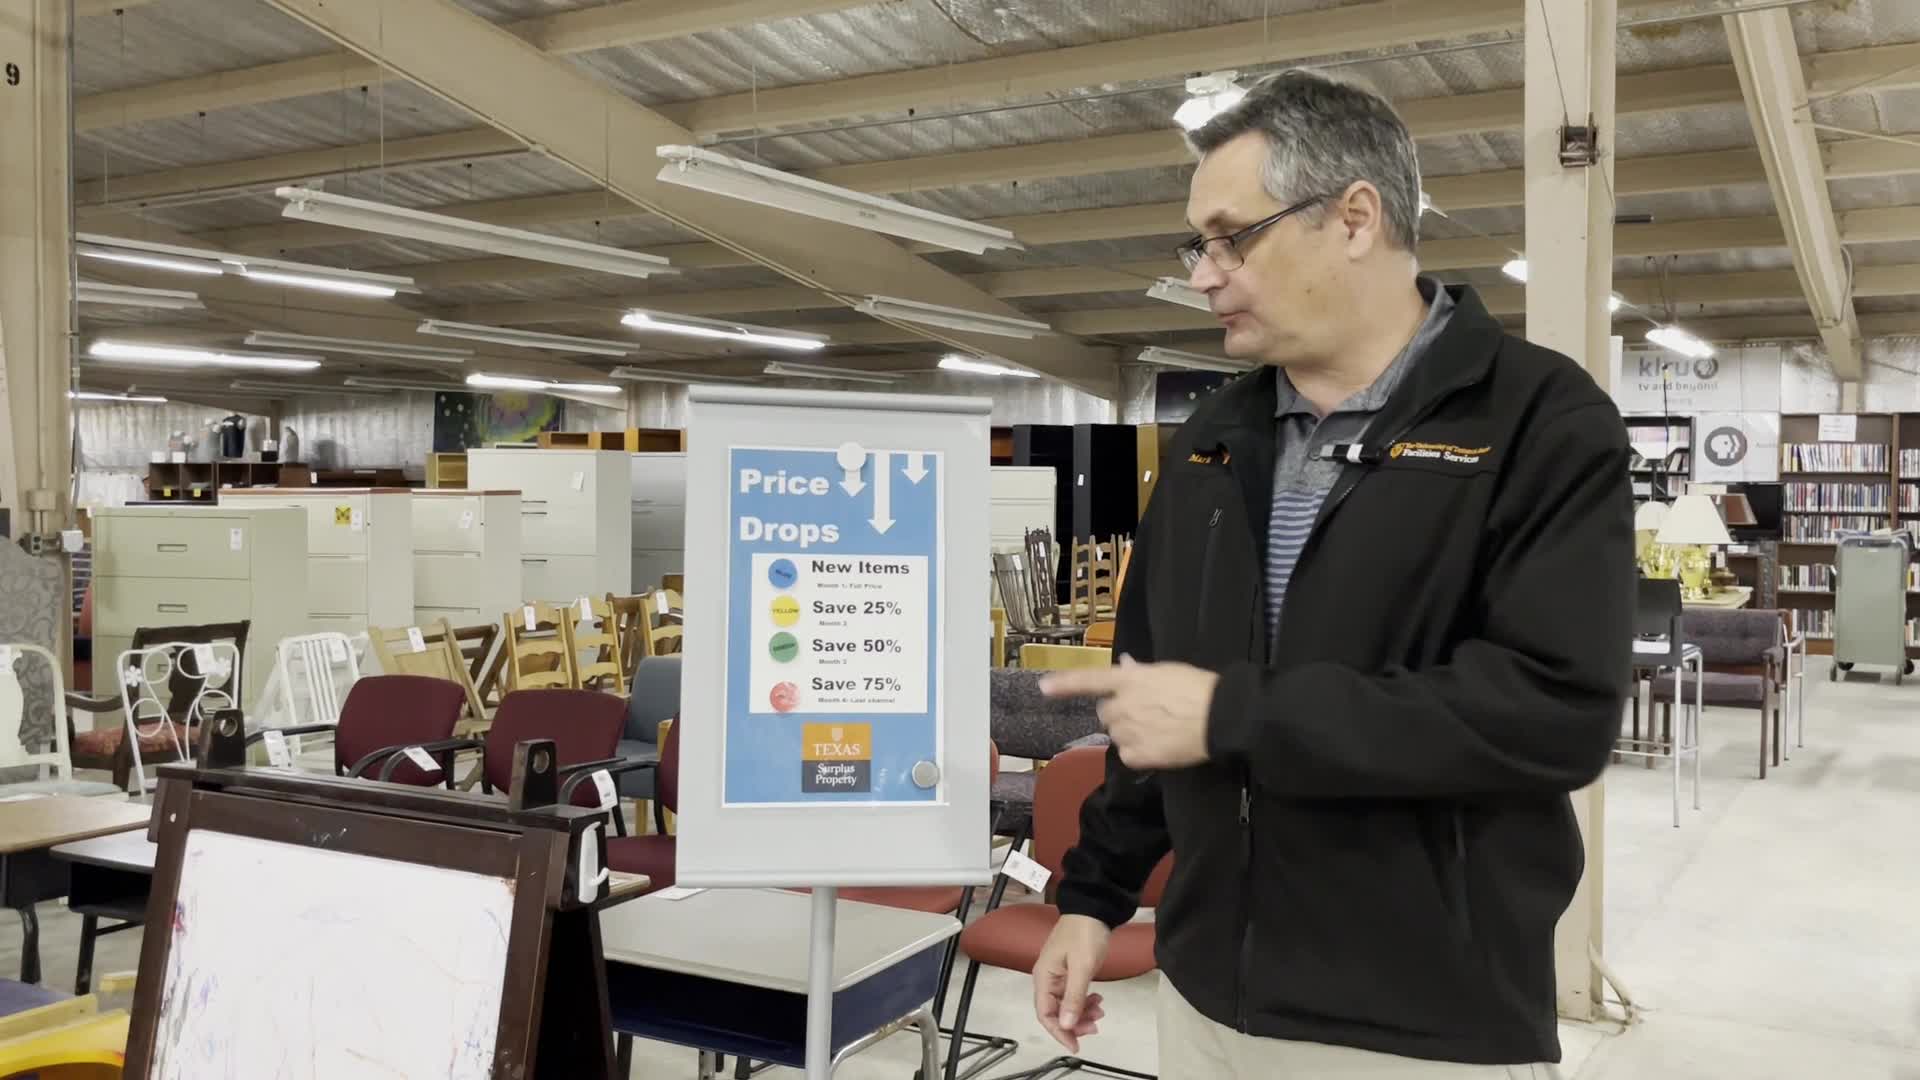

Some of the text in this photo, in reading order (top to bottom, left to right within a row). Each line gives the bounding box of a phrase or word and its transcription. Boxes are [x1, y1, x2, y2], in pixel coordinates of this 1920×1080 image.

[6, 62, 20, 86] 9
[1402, 448, 1441, 458] Facilities
[740, 468, 830, 495] Price
[740, 516, 840, 548] Drops
[811, 560, 910, 574] New Items
[812, 600, 902, 615] Save 25%
[812, 638, 857, 652] Save
[863, 639, 902, 653] 50%
[811, 676, 902, 691] Save 75%
[813, 743, 861, 756] TEXAS
[817, 763, 856, 775] Surplus
[815, 774, 857, 787] Property
